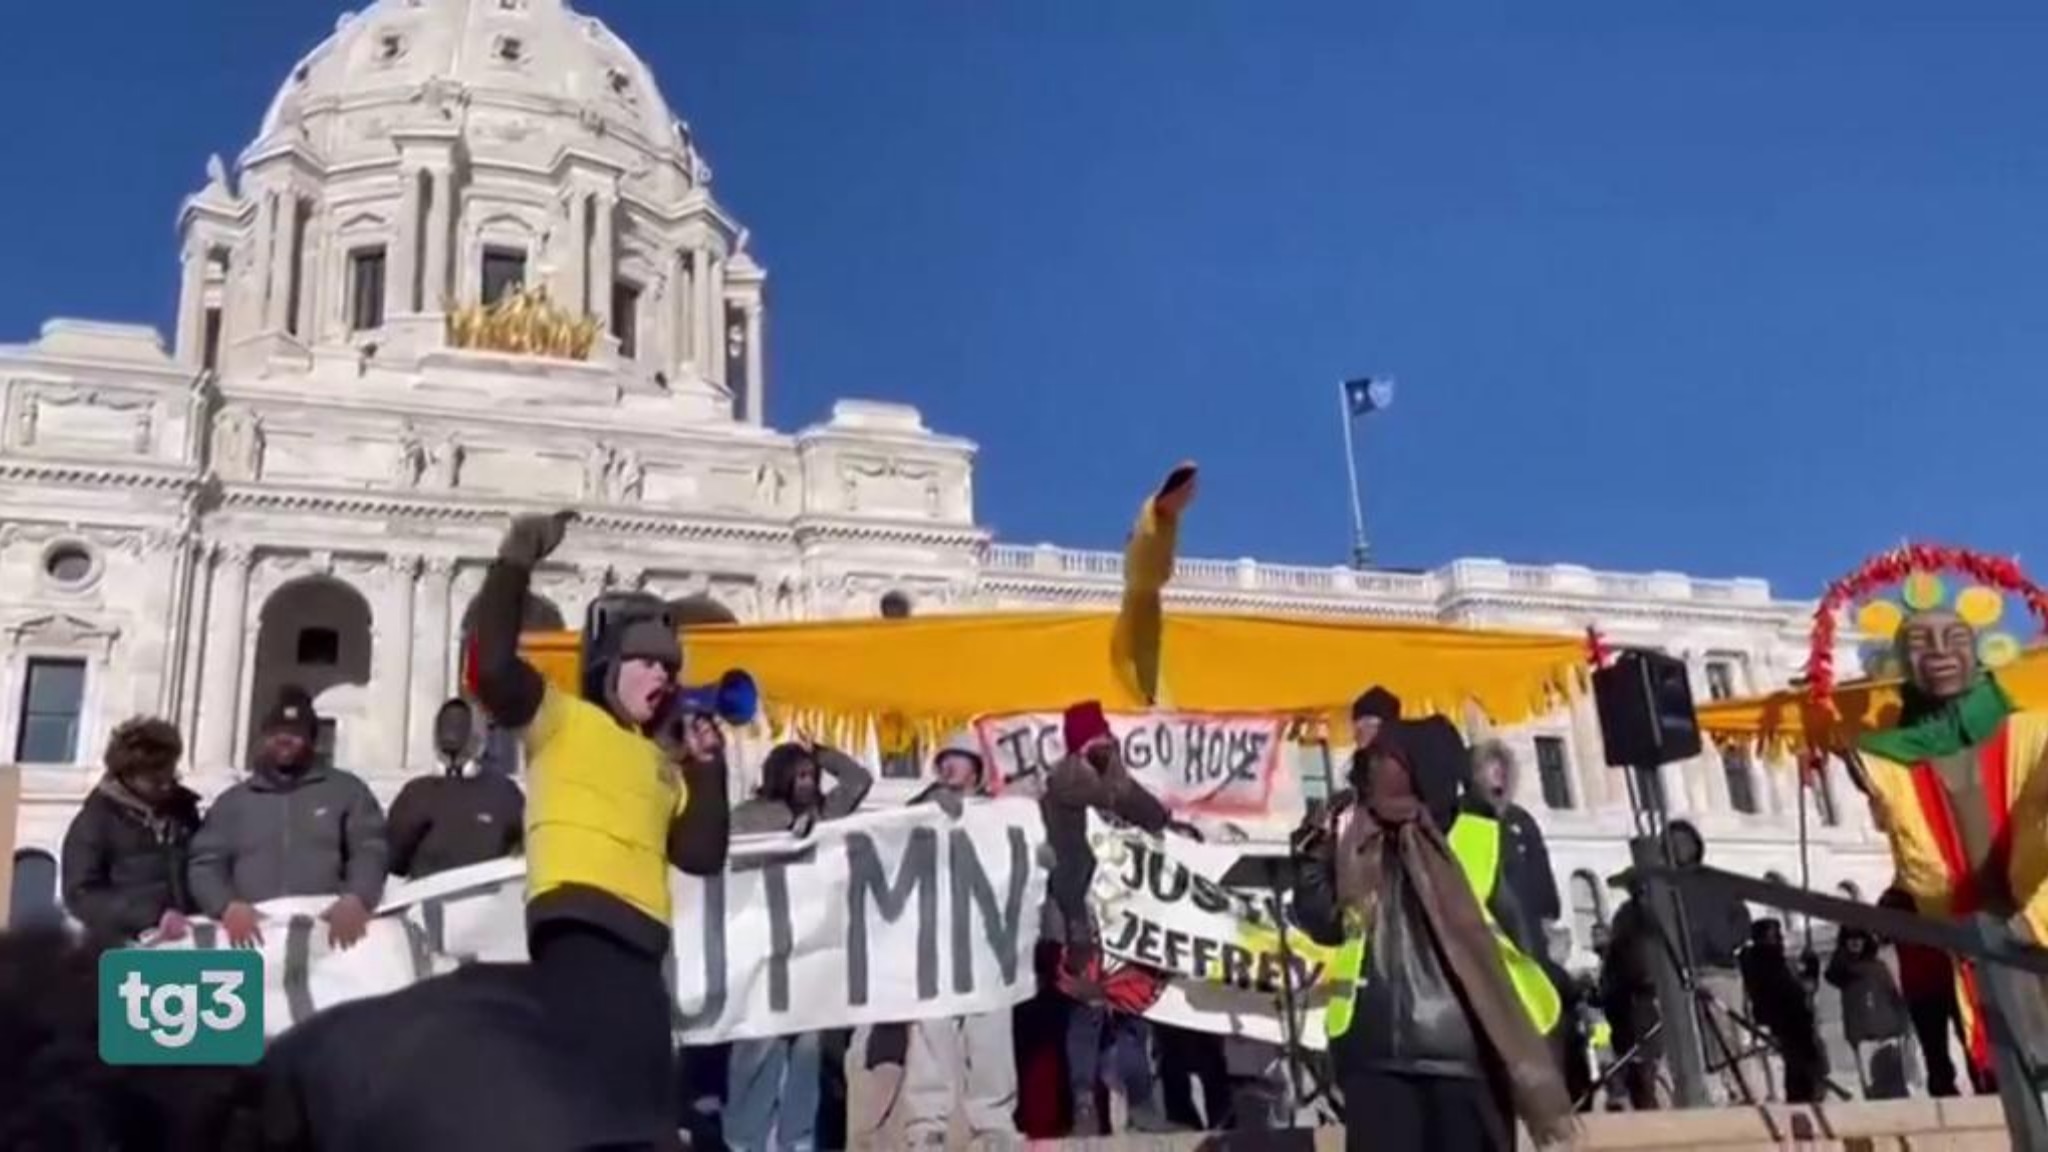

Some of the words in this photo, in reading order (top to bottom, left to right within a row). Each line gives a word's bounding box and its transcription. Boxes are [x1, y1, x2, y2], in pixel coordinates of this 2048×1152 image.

[997, 726, 1060, 784] IC
[1124, 723, 1174, 769] GO
[1184, 722, 1269, 784] HOME
[661, 842, 817, 1030] UT
[846, 825, 1029, 1006] MN
[1106, 911, 1326, 993] JEFFREY
